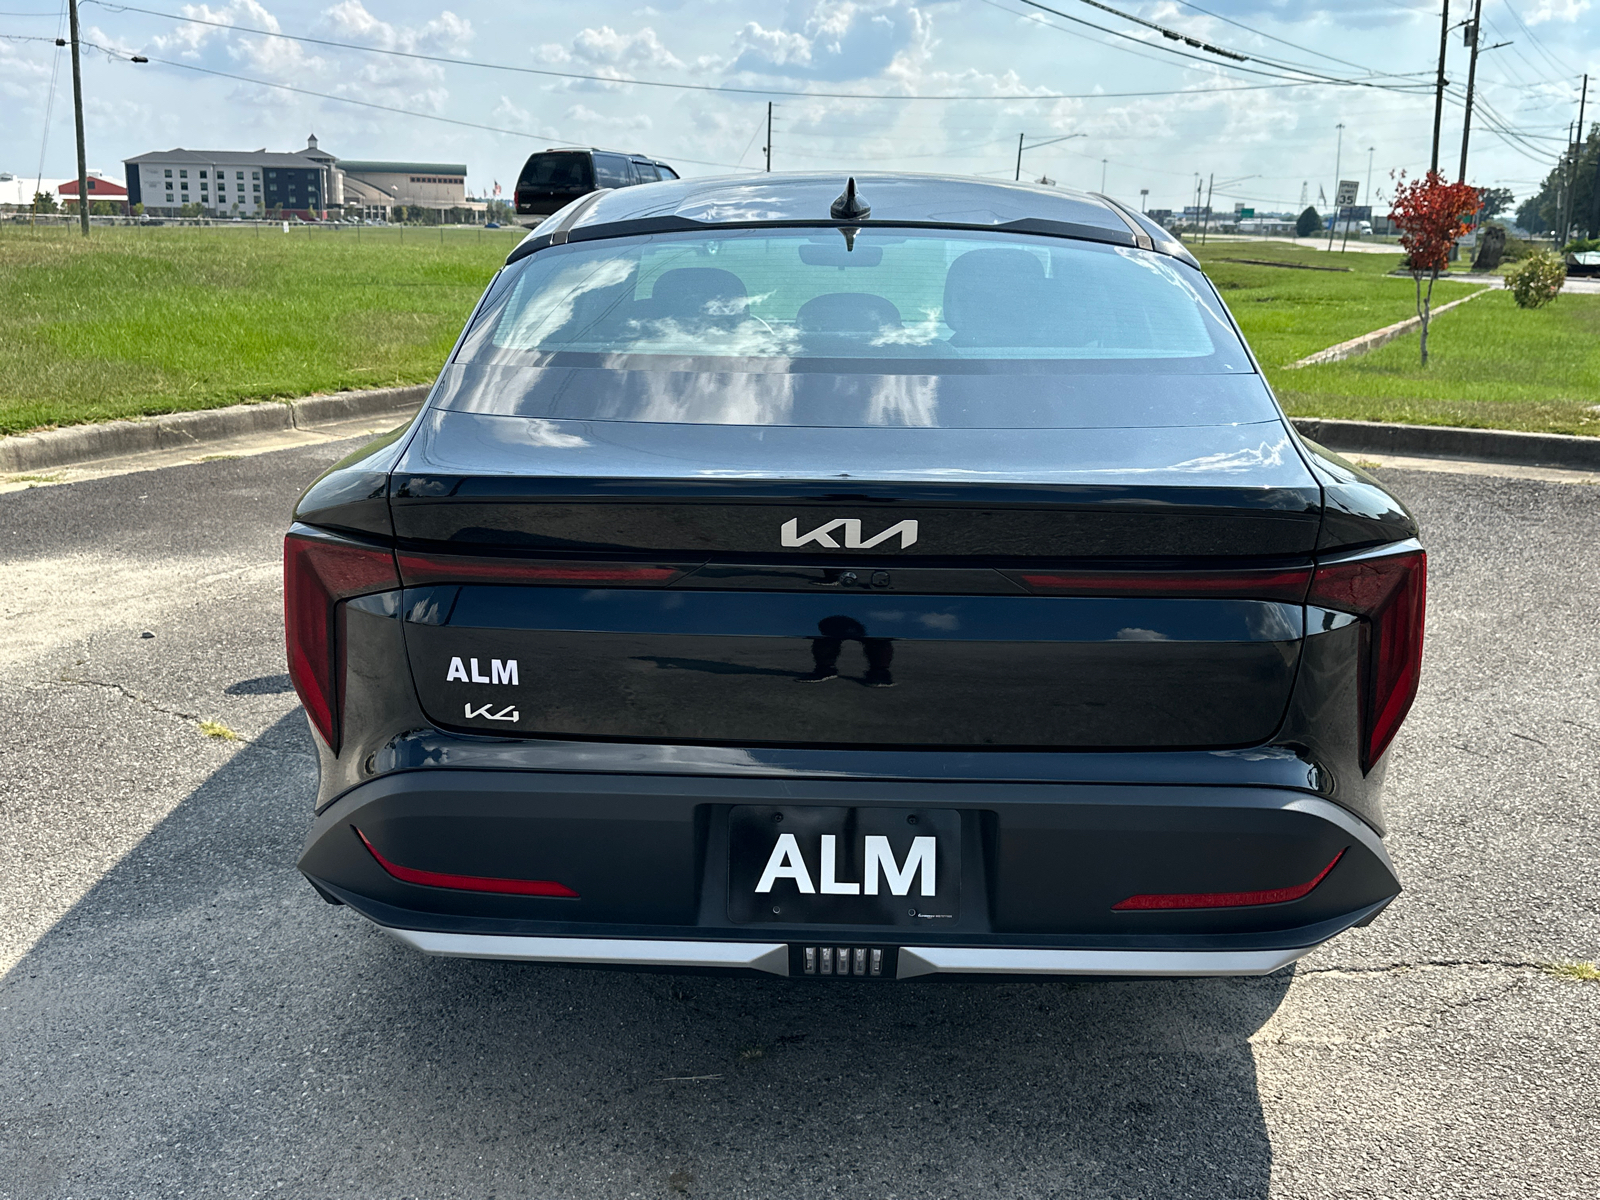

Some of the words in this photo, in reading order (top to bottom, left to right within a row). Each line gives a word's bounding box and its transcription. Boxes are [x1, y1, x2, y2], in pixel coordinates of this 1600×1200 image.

[1339, 195, 1354, 205] 35
[781, 517, 918, 549] KIA
[446, 656, 519, 686] ALM
[464, 702, 519, 723] K4
[754, 833, 937, 897] ALM
